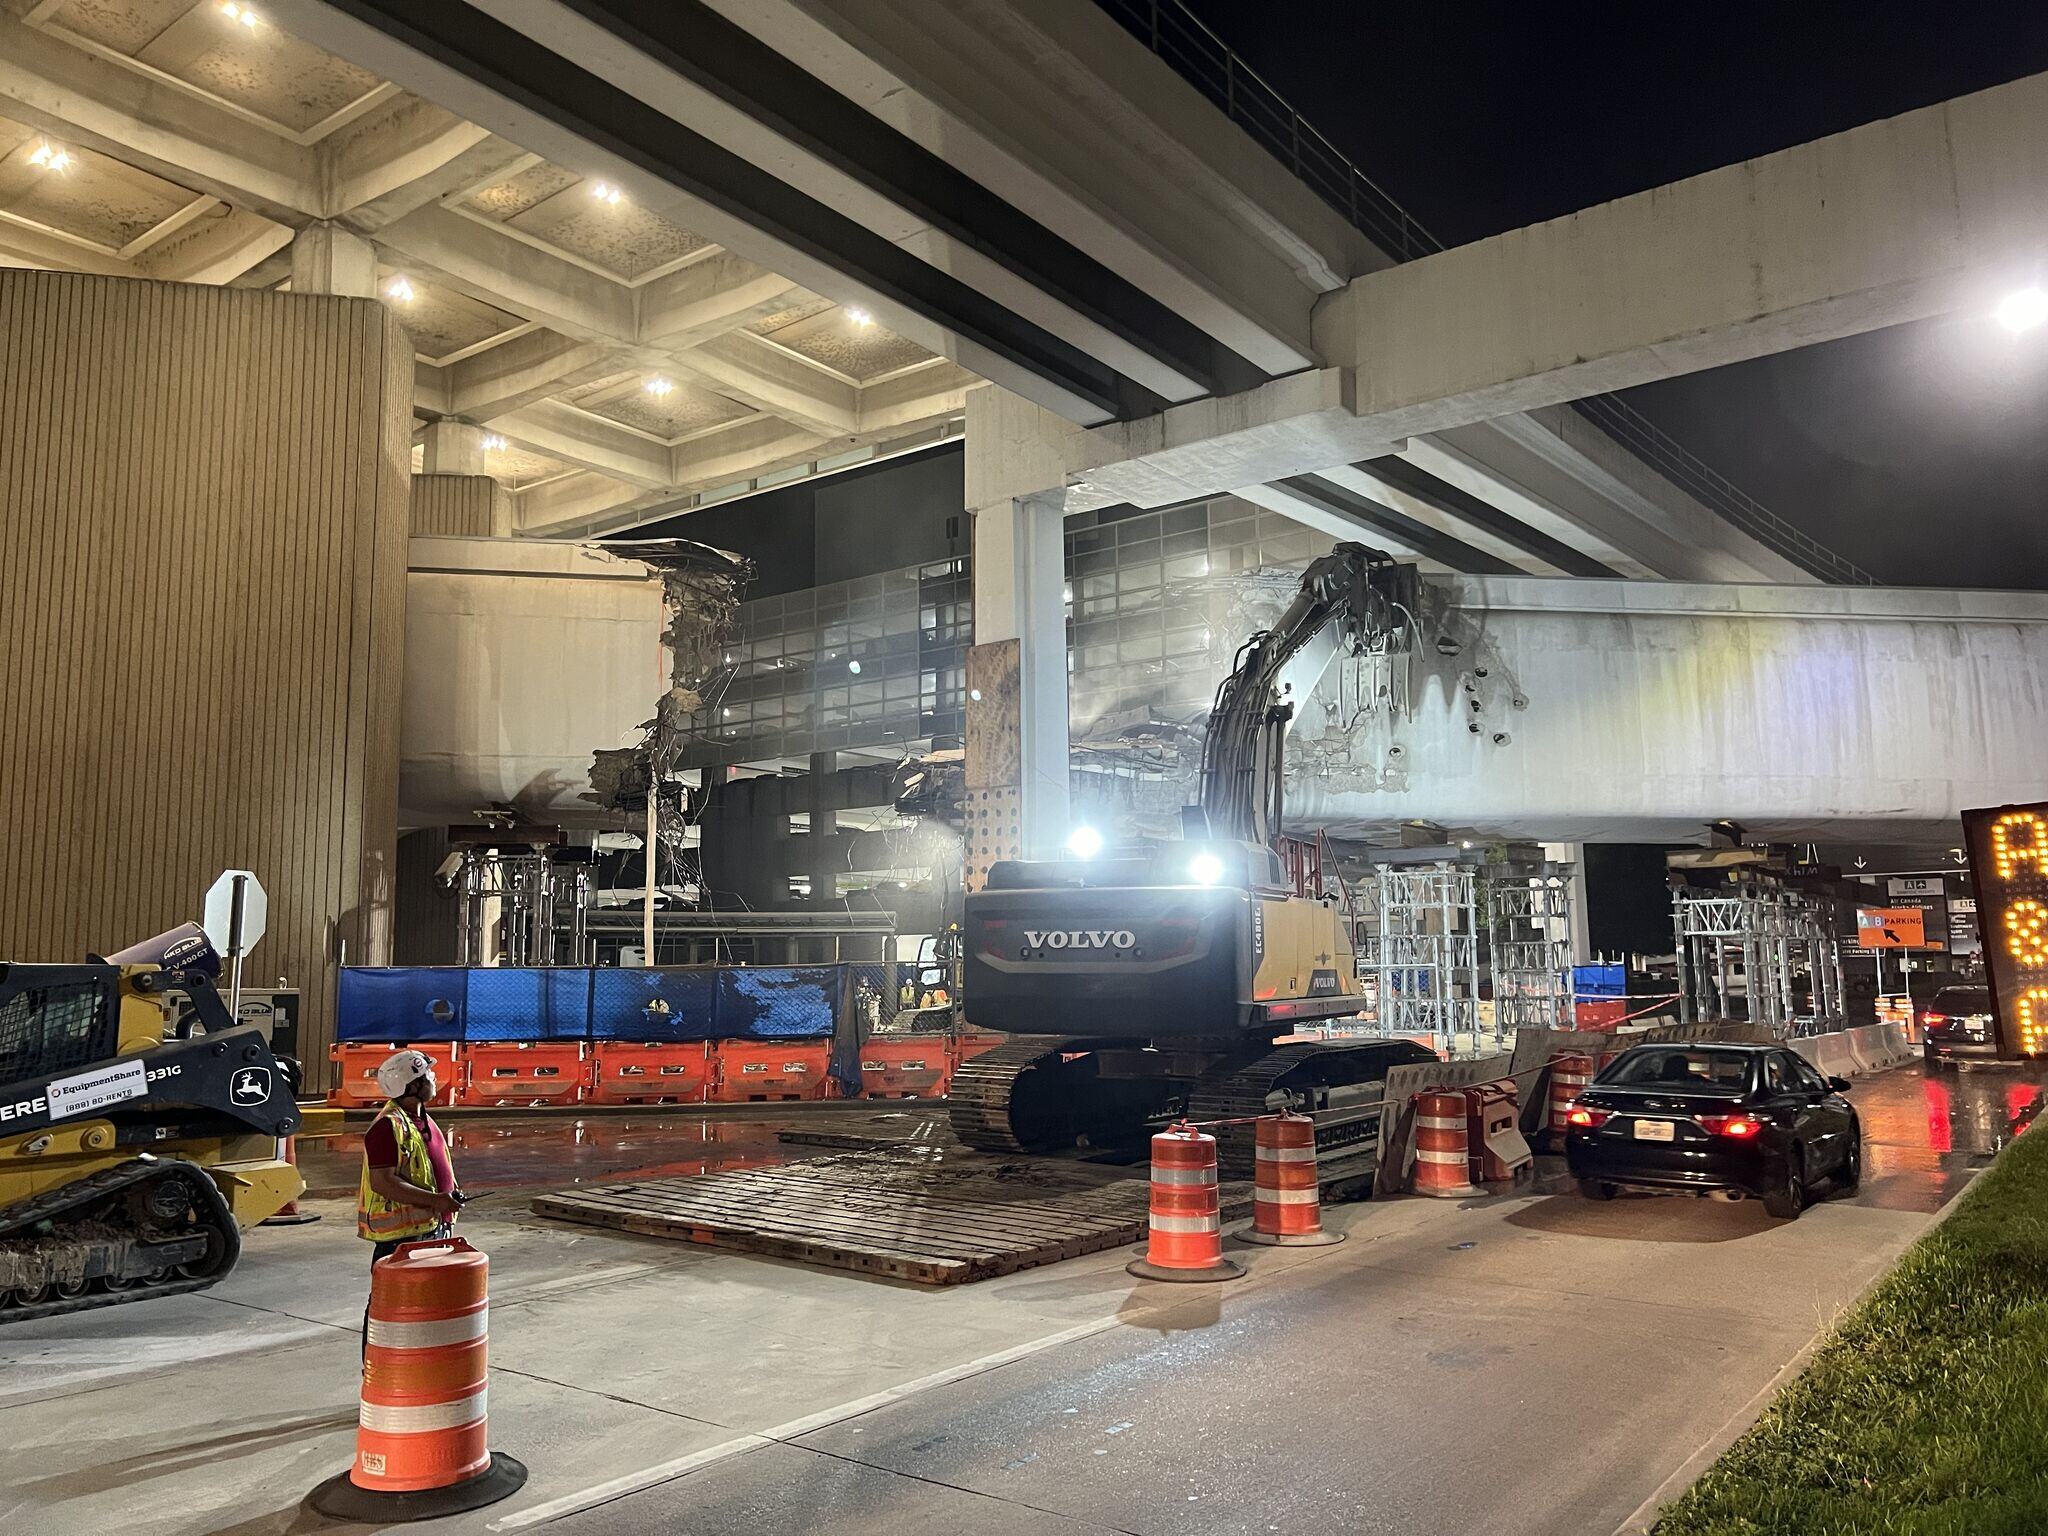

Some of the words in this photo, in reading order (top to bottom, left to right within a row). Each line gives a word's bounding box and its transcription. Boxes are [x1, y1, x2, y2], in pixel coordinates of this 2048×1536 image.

[1861, 918, 1869, 926] A
[1874, 917, 1882, 926] B
[1884, 917, 1922, 925] PARKING
[1024, 930, 1136, 949] VOLVO
[62, 1069, 141, 1095] EquipmentShare
[146, 1065, 182, 1082] 331G
[65, 1100, 90, 1113] (888)
